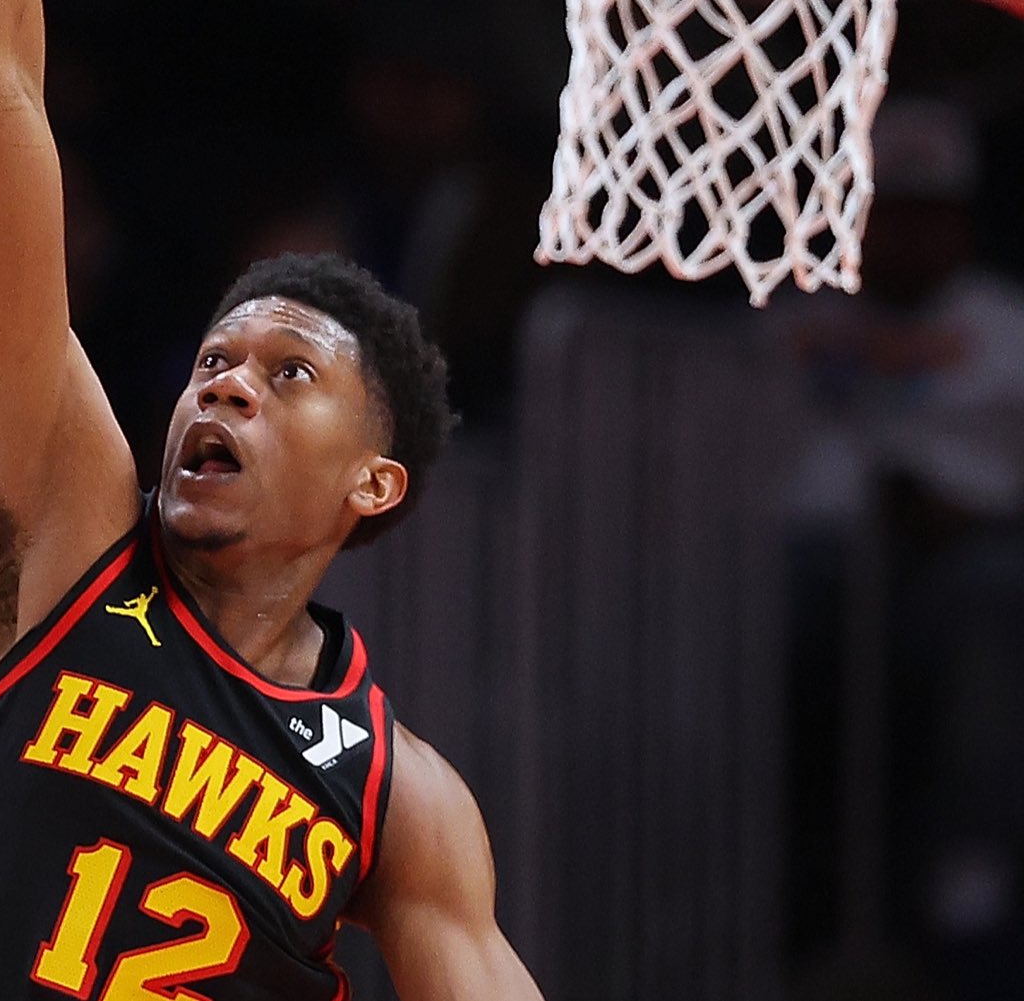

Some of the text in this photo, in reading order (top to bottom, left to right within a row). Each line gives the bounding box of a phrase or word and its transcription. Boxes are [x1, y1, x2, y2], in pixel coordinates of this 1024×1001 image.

[20, 670, 357, 920] HAWKS
[289, 717, 313, 741] the
[30, 837, 250, 1001] 12
